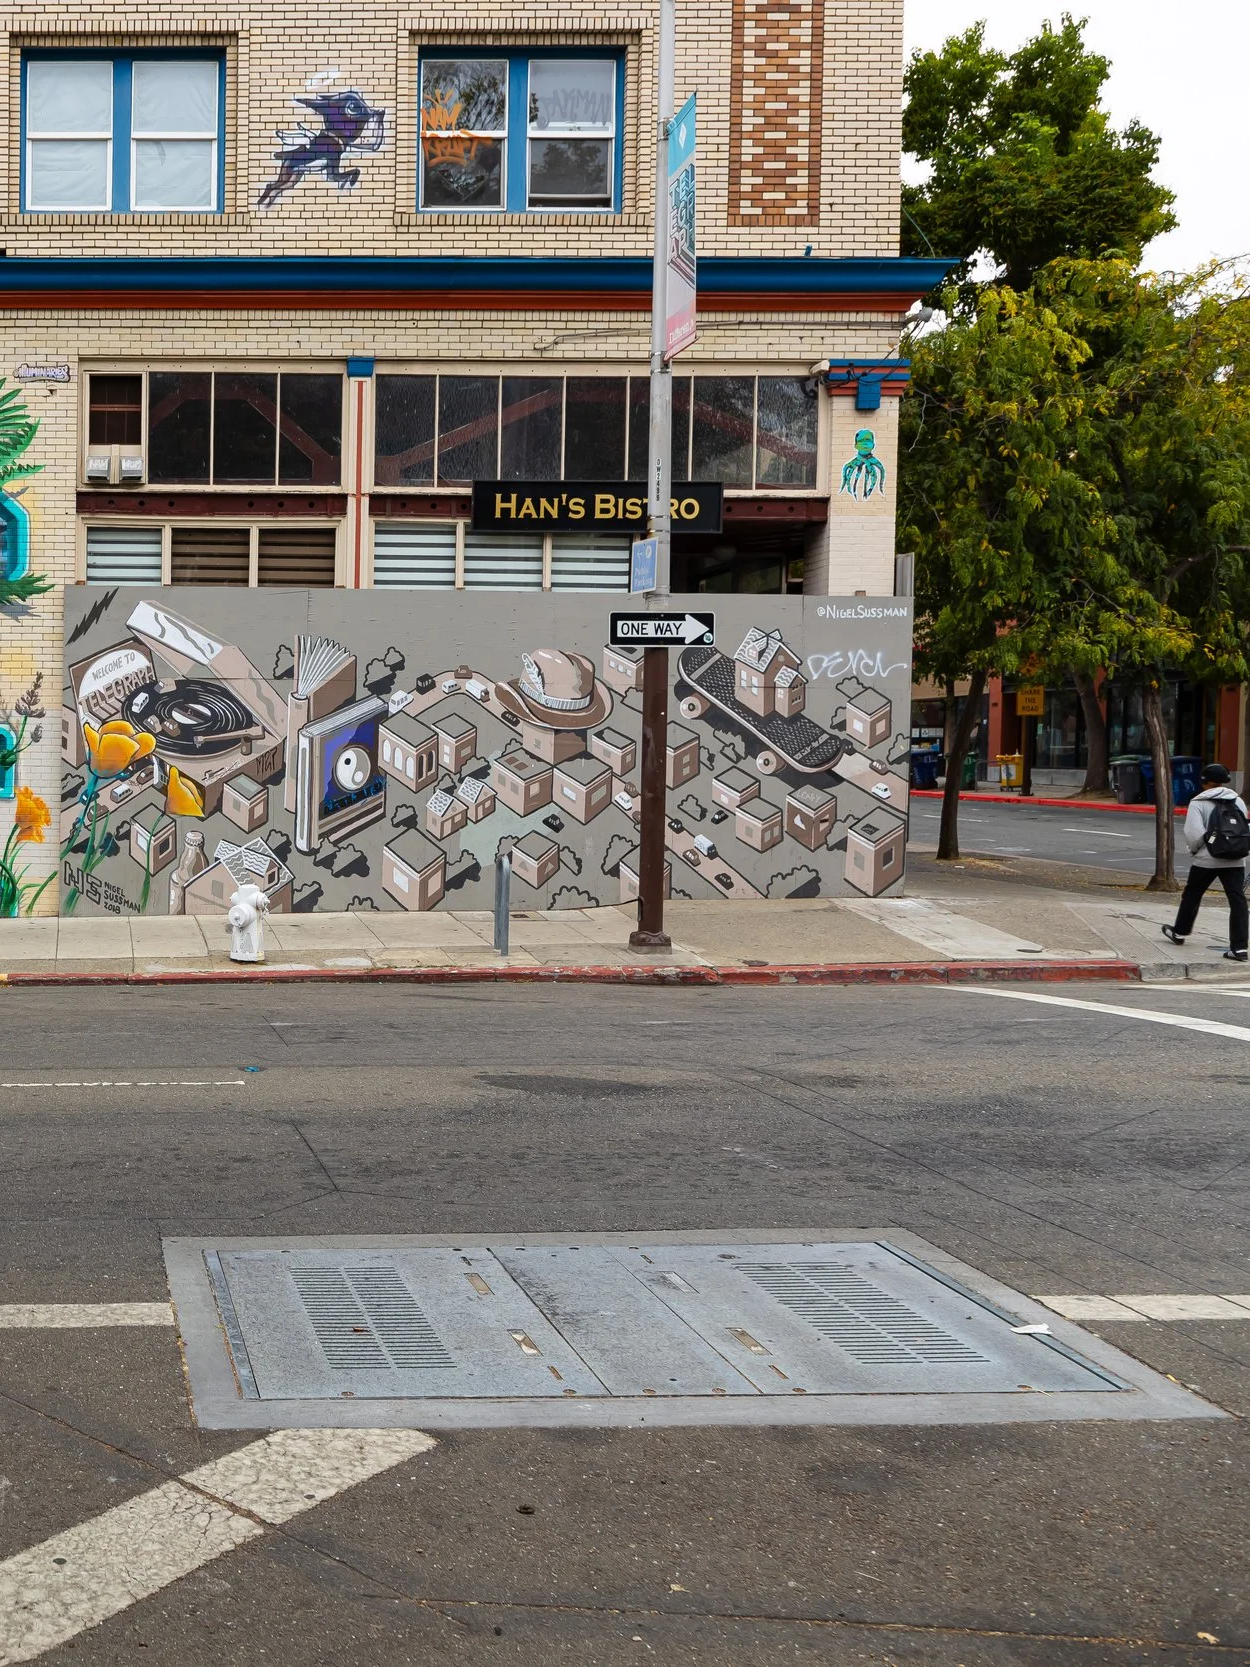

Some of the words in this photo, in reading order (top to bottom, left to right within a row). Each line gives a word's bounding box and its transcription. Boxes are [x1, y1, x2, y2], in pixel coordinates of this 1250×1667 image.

[494, 493, 586, 519] HAN'S
[621, 623, 648, 635] ONE
[654, 623, 682, 635] WAY
[92, 657, 123, 681] WELCOME
[124, 652, 136, 664] TO
[78, 663, 155, 713] TELEGRAPH
[104, 882, 126, 898] NIGEL
[104, 890, 141, 914] SUSSMAN
[104, 902, 121, 914] 2018
